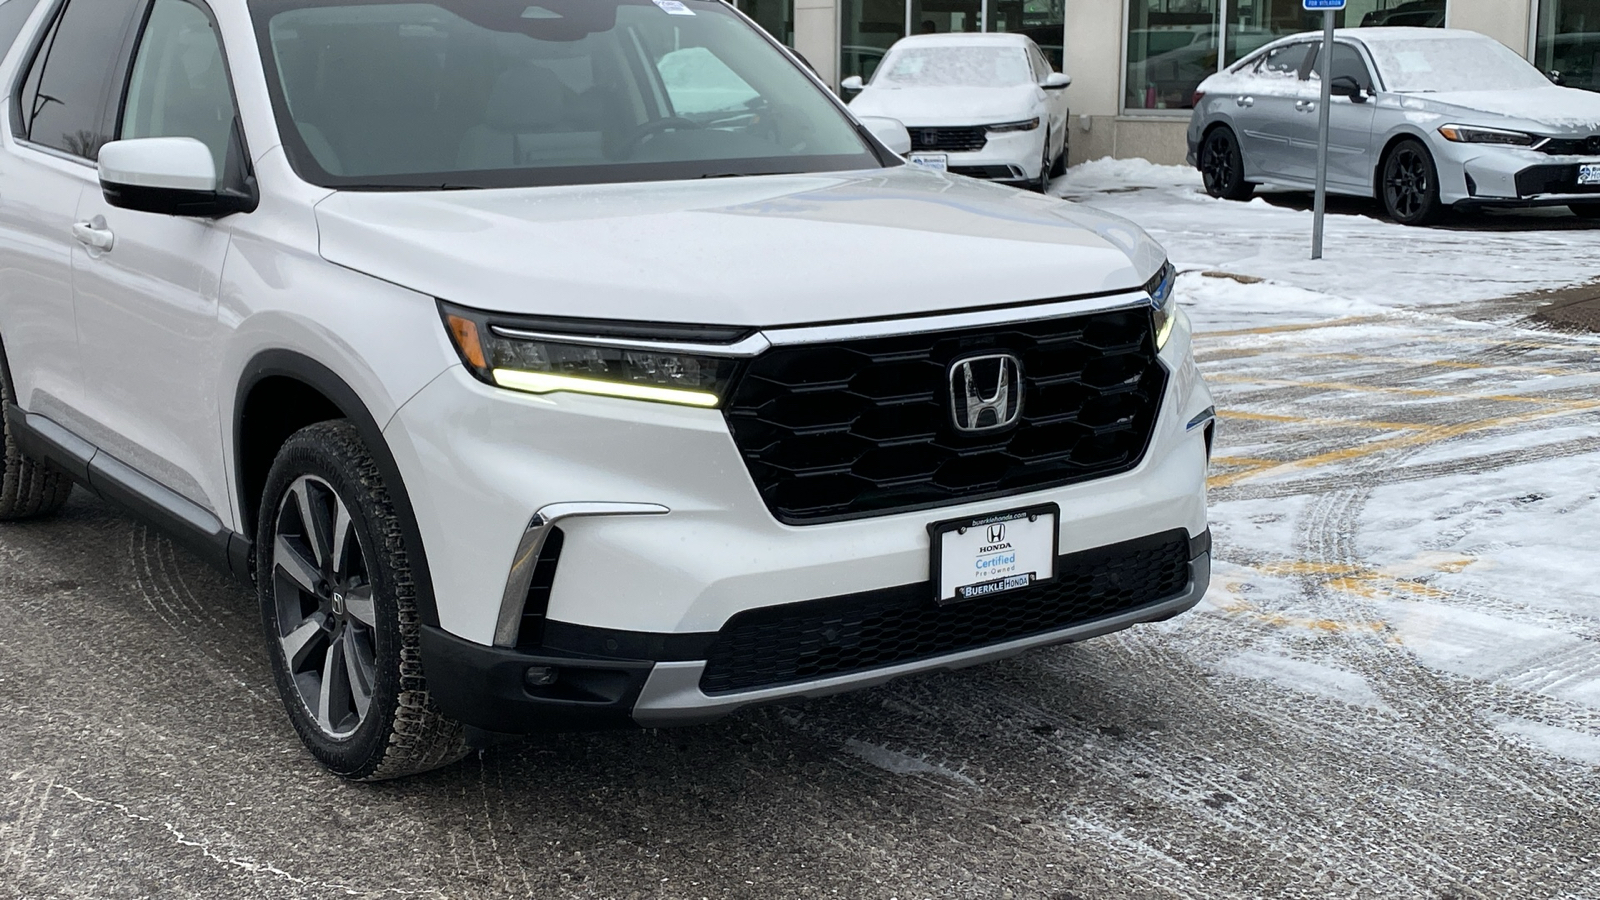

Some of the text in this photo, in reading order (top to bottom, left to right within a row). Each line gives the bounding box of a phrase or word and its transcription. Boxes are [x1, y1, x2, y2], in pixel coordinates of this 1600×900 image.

[972, 512, 1027, 526] buerklehonda.com
[979, 543, 1012, 553] HONDA
[975, 553, 1015, 569] Certified
[975, 565, 1015, 577] Pre-Owned
